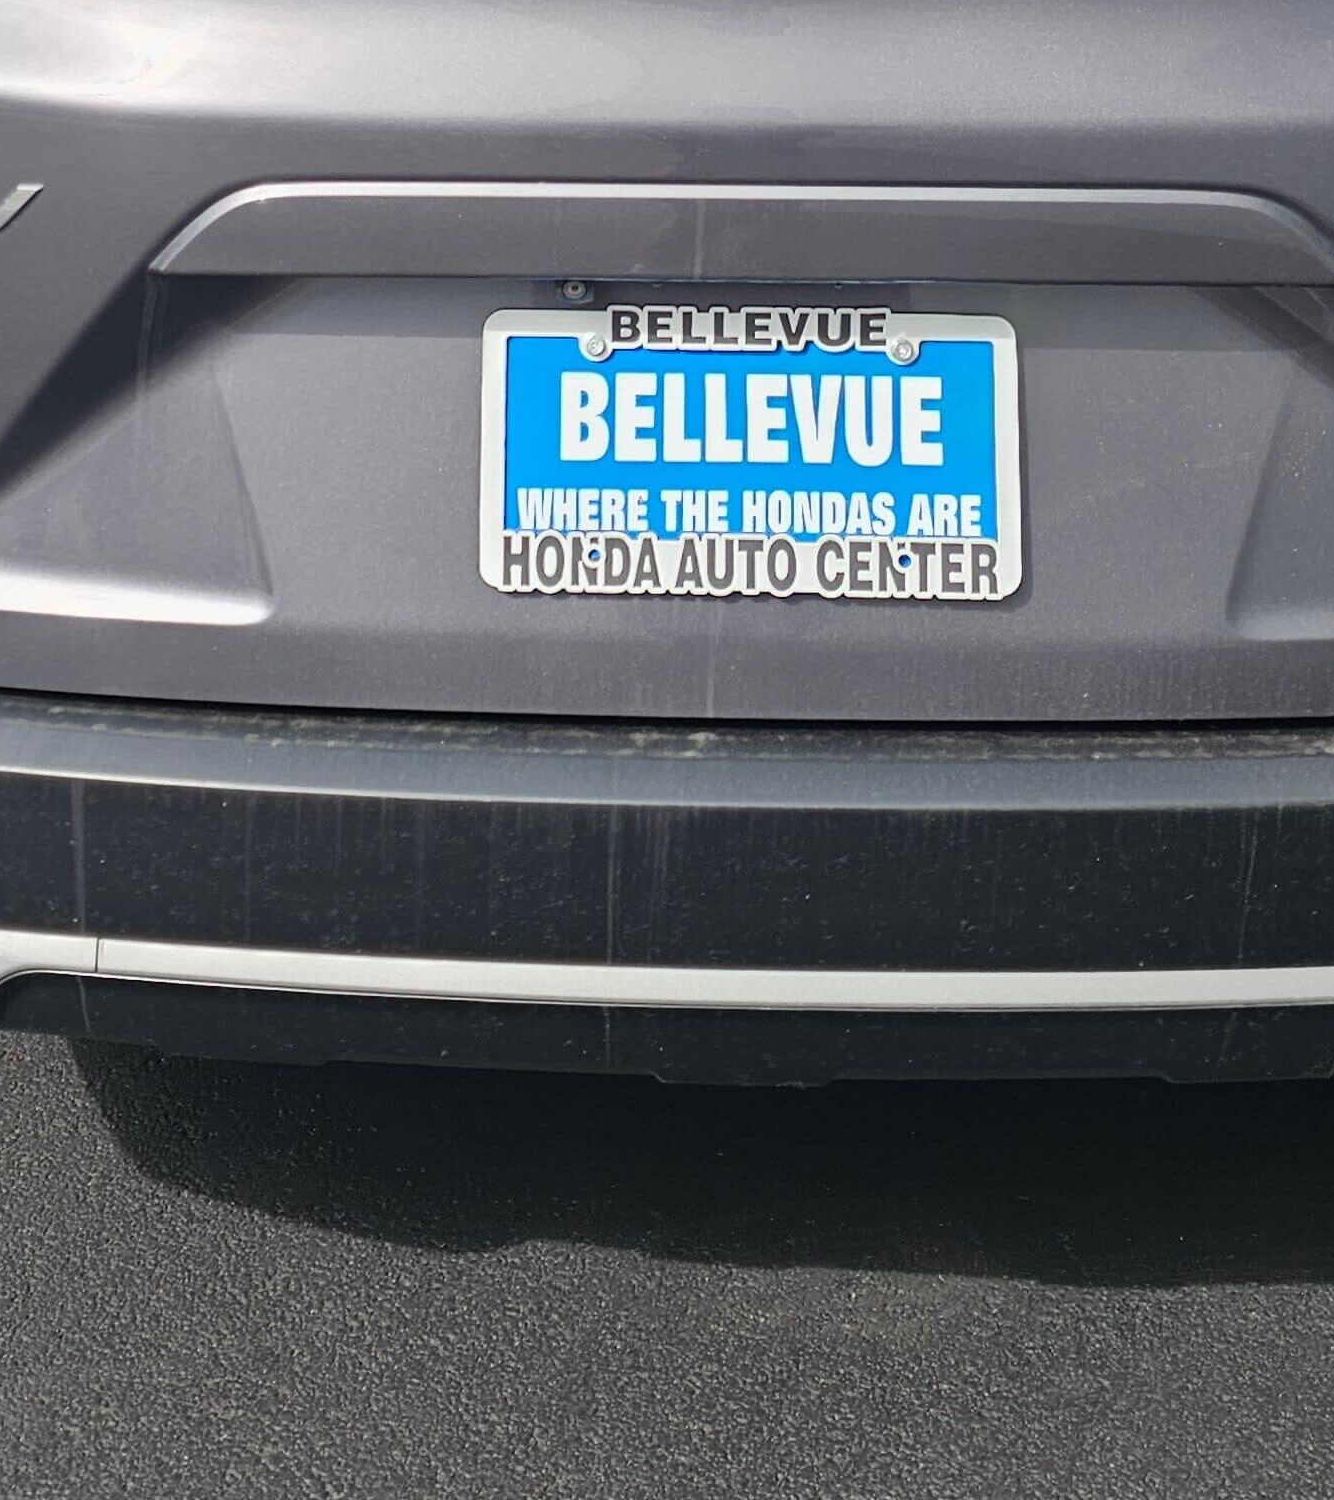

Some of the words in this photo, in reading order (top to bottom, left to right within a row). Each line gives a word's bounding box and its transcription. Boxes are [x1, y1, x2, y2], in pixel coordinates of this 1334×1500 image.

[611, 308, 888, 348] BELLEVUE
[559, 371, 944, 467] BELLEVUE
[517, 487, 649, 532] WHERE
[661, 489, 729, 532] THE
[741, 490, 897, 536] HONDAS
[907, 493, 983, 538] ARE
[502, 535, 662, 588] HONDA
[675, 537, 798, 592] AUTO
[816, 538, 999, 595] CENTER
